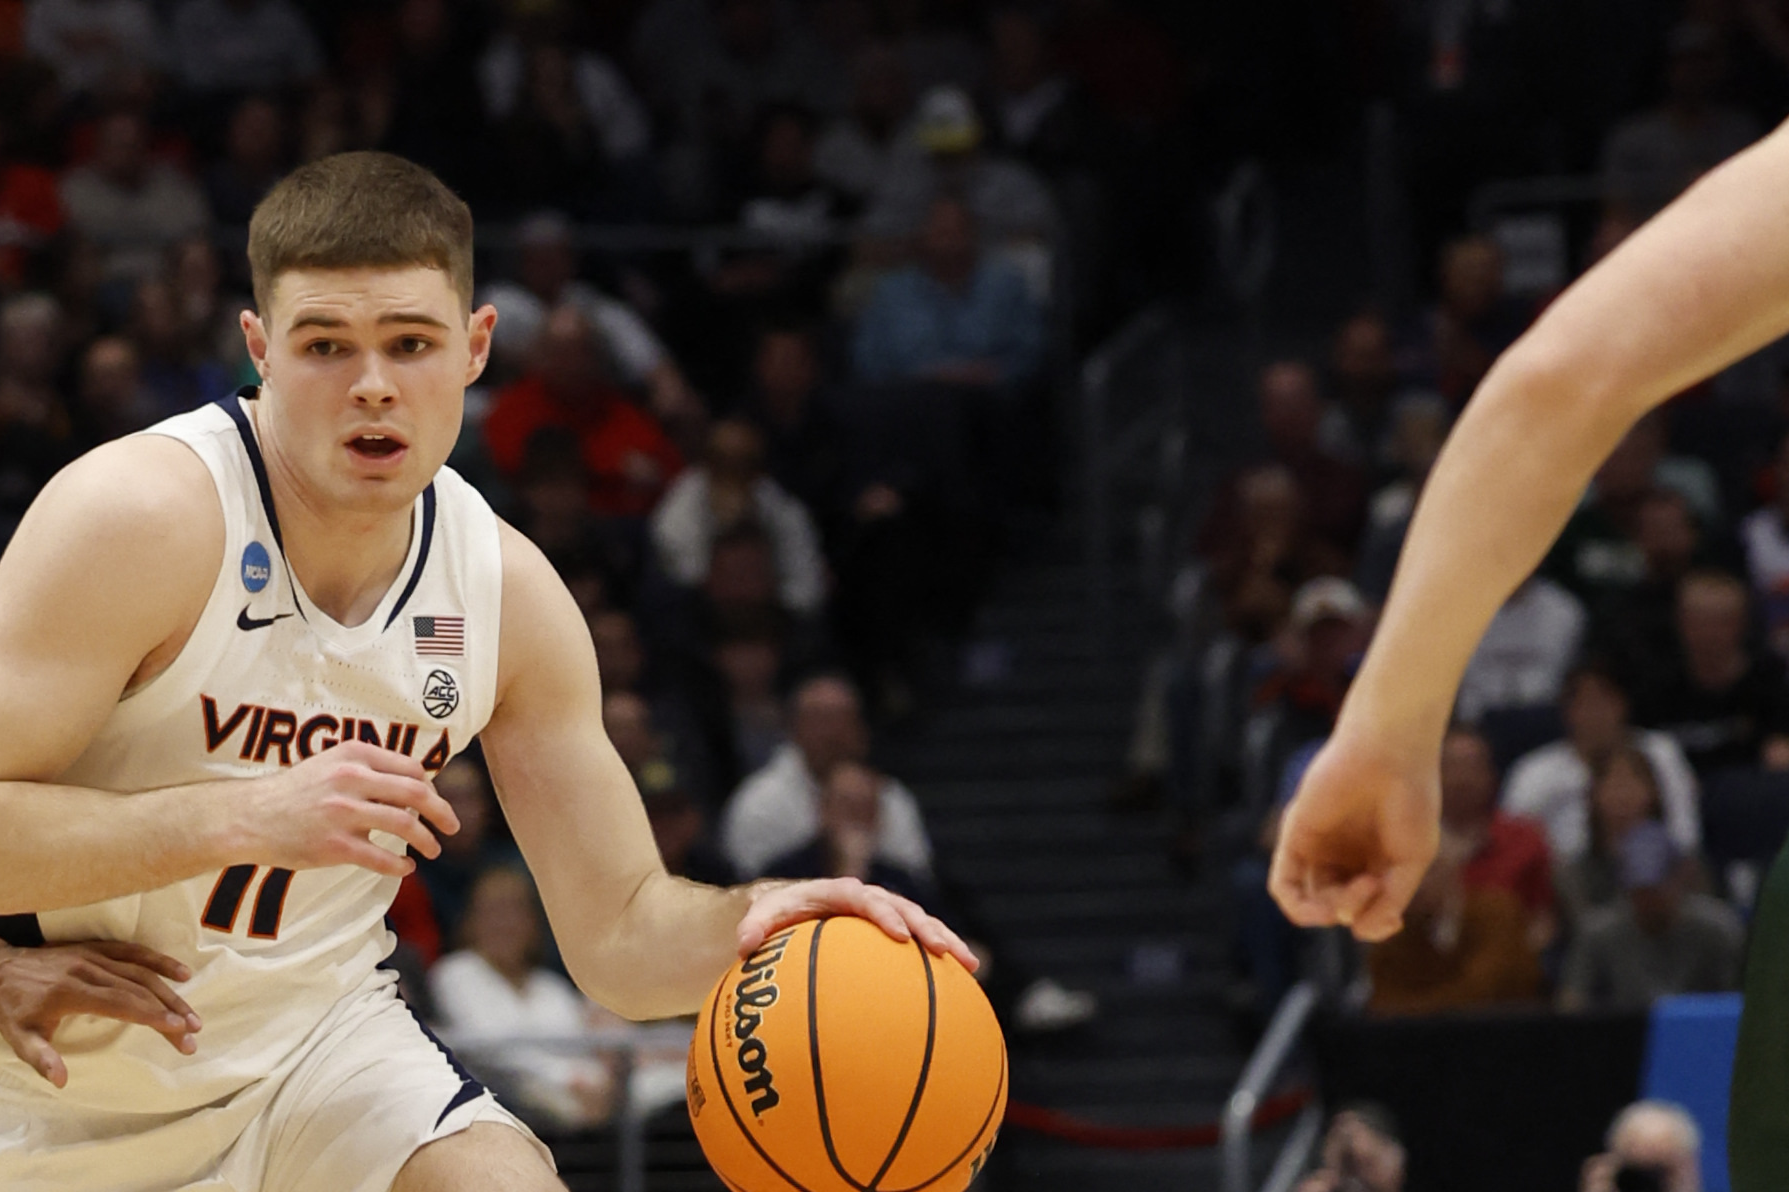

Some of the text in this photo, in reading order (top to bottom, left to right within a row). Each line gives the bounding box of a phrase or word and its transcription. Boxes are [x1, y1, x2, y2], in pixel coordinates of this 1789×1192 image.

[428, 686, 457, 698] ACC
[200, 864, 297, 941] 11
[734, 928, 798, 1119] Wilson
